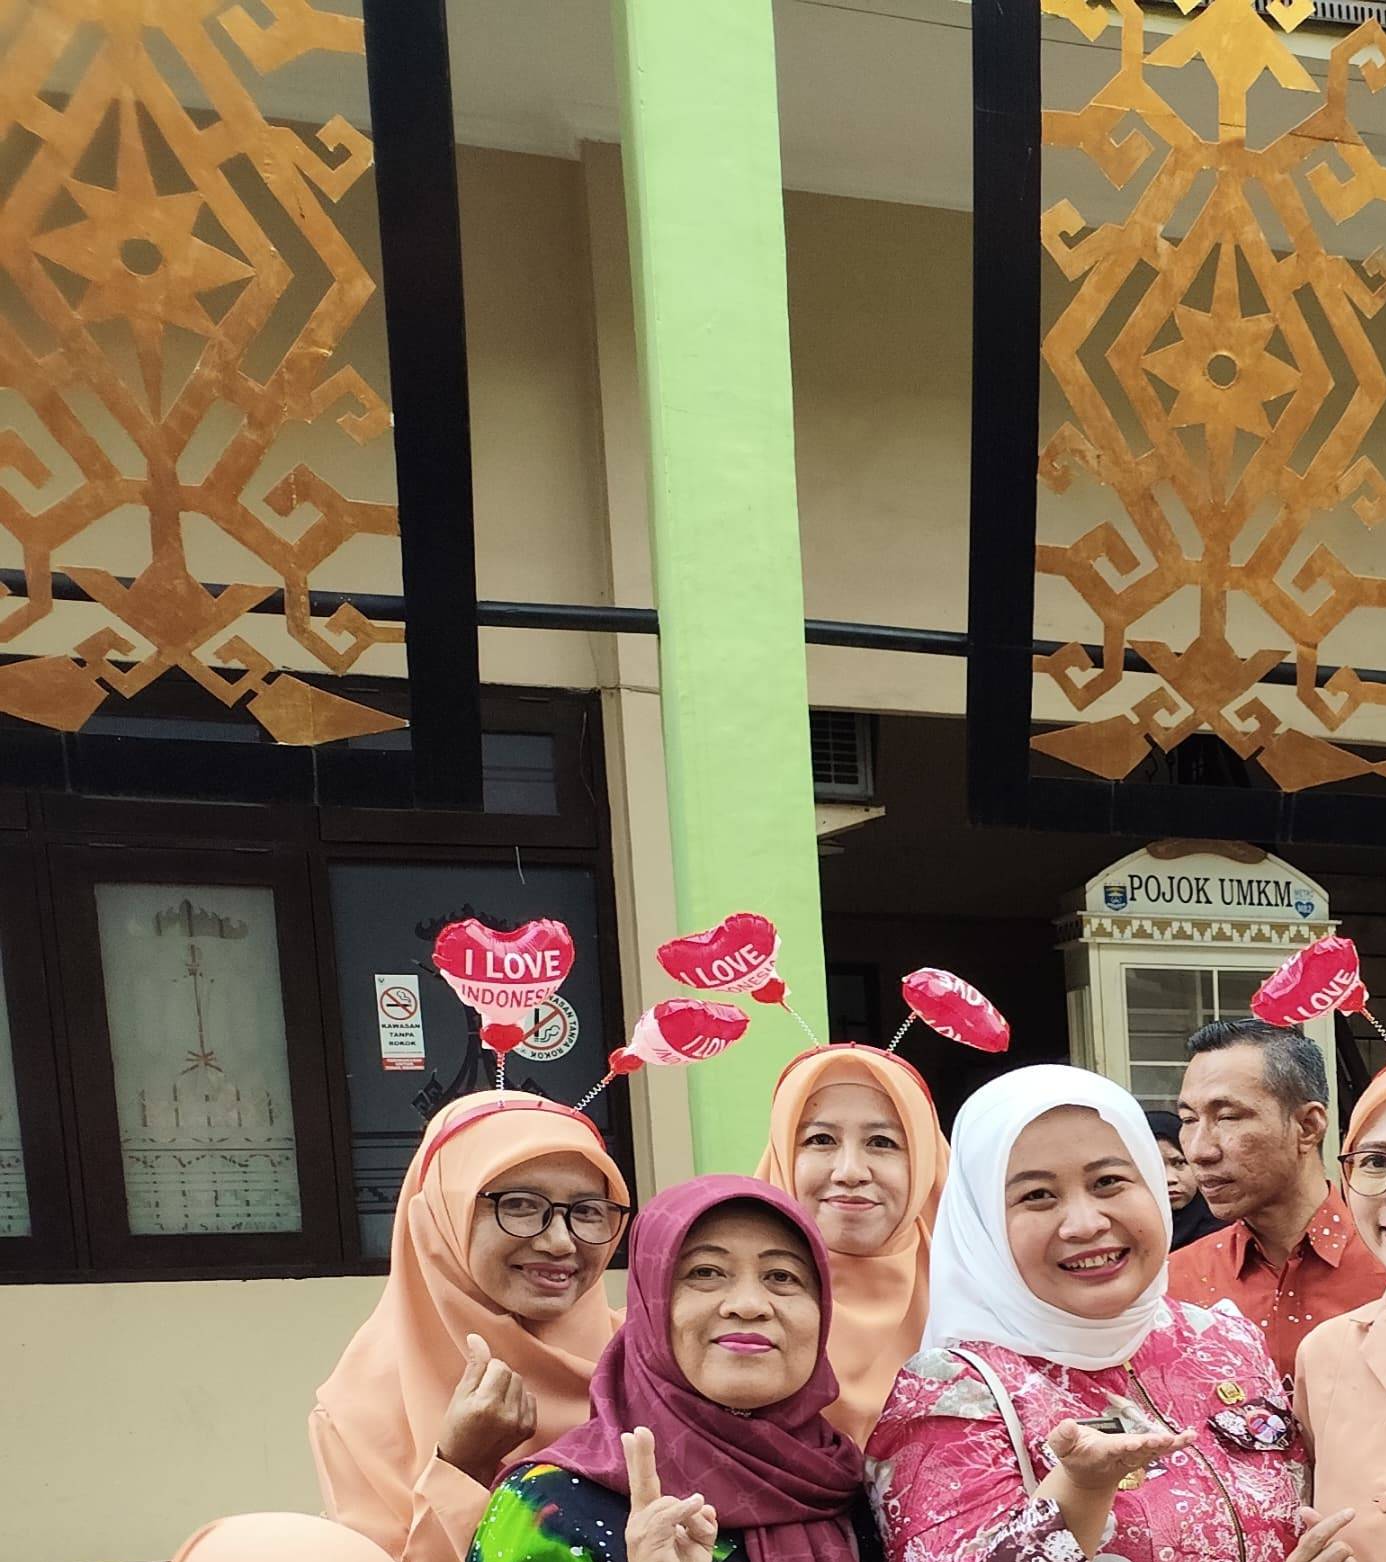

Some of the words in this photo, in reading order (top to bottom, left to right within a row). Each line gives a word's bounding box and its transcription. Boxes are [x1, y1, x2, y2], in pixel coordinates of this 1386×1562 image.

[1128, 874, 1213, 905] POJOK
[1219, 878, 1294, 908] UMKM
[465, 948, 474, 976] I
[486, 949, 561, 979] LOVE
[679, 971, 698, 988] I
[695, 943, 766, 986] LOVE
[461, 983, 557, 1009] INDONESI
[1296, 968, 1356, 1018] LOVE
[563, 1021, 577, 1048] TANPA
[682, 1034, 704, 1051] I
[692, 1036, 734, 1058] LOV
[530, 1047, 565, 1059] ROKOK
